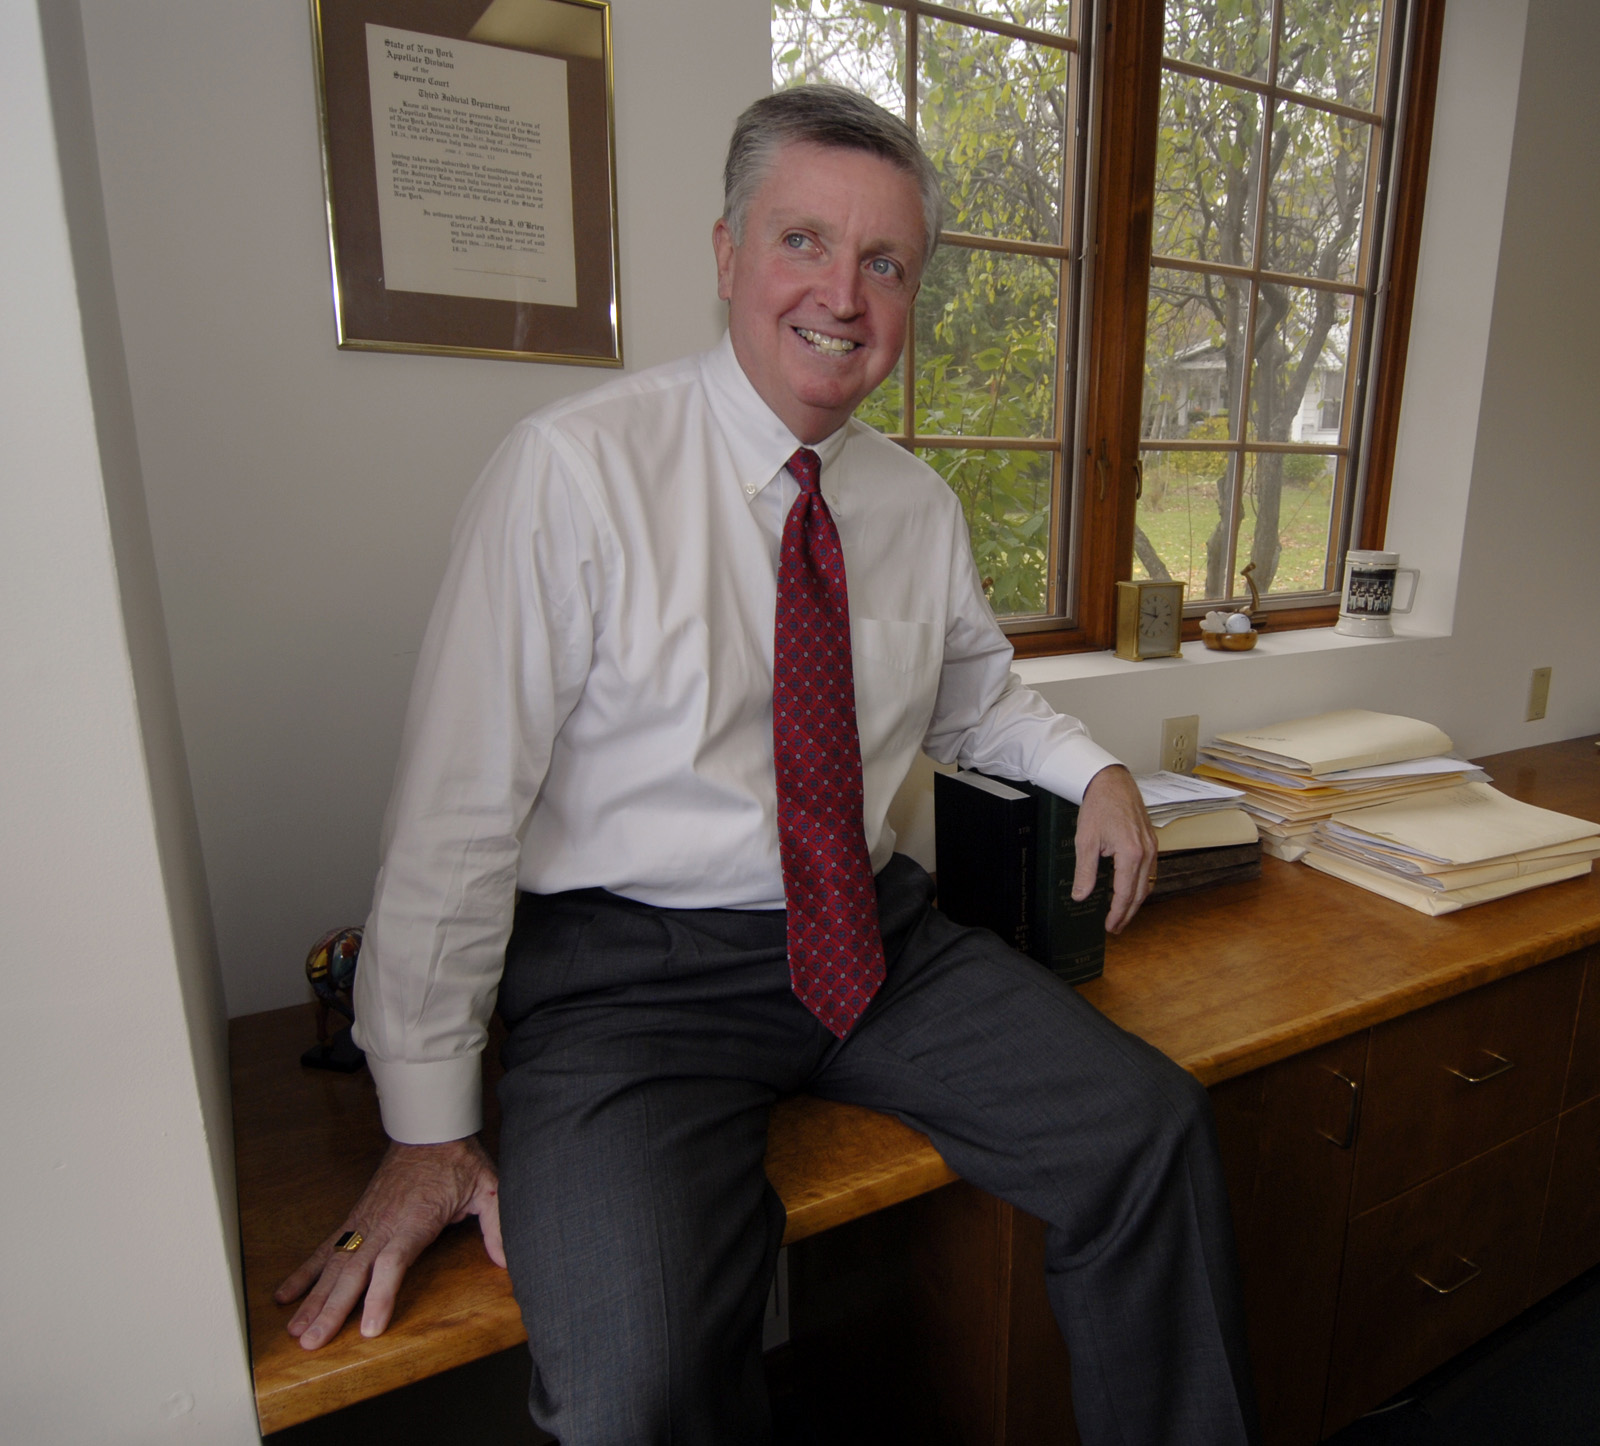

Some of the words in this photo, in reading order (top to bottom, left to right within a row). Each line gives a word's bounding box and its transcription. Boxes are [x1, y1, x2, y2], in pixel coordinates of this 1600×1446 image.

[384, 39, 404, 49] State
[406, 43, 414, 51] of
[417, 44, 434, 55] New
[435, 47, 454, 58] York
[386, 49, 422, 63] Appellate
[424, 56, 454, 69] Division
[393, 71, 426, 84] Supreme
[428, 77, 449, 88] Court
[418, 88, 439, 100] Third
[441, 92, 469, 105] Judicial
[471, 97, 510, 112] Department
